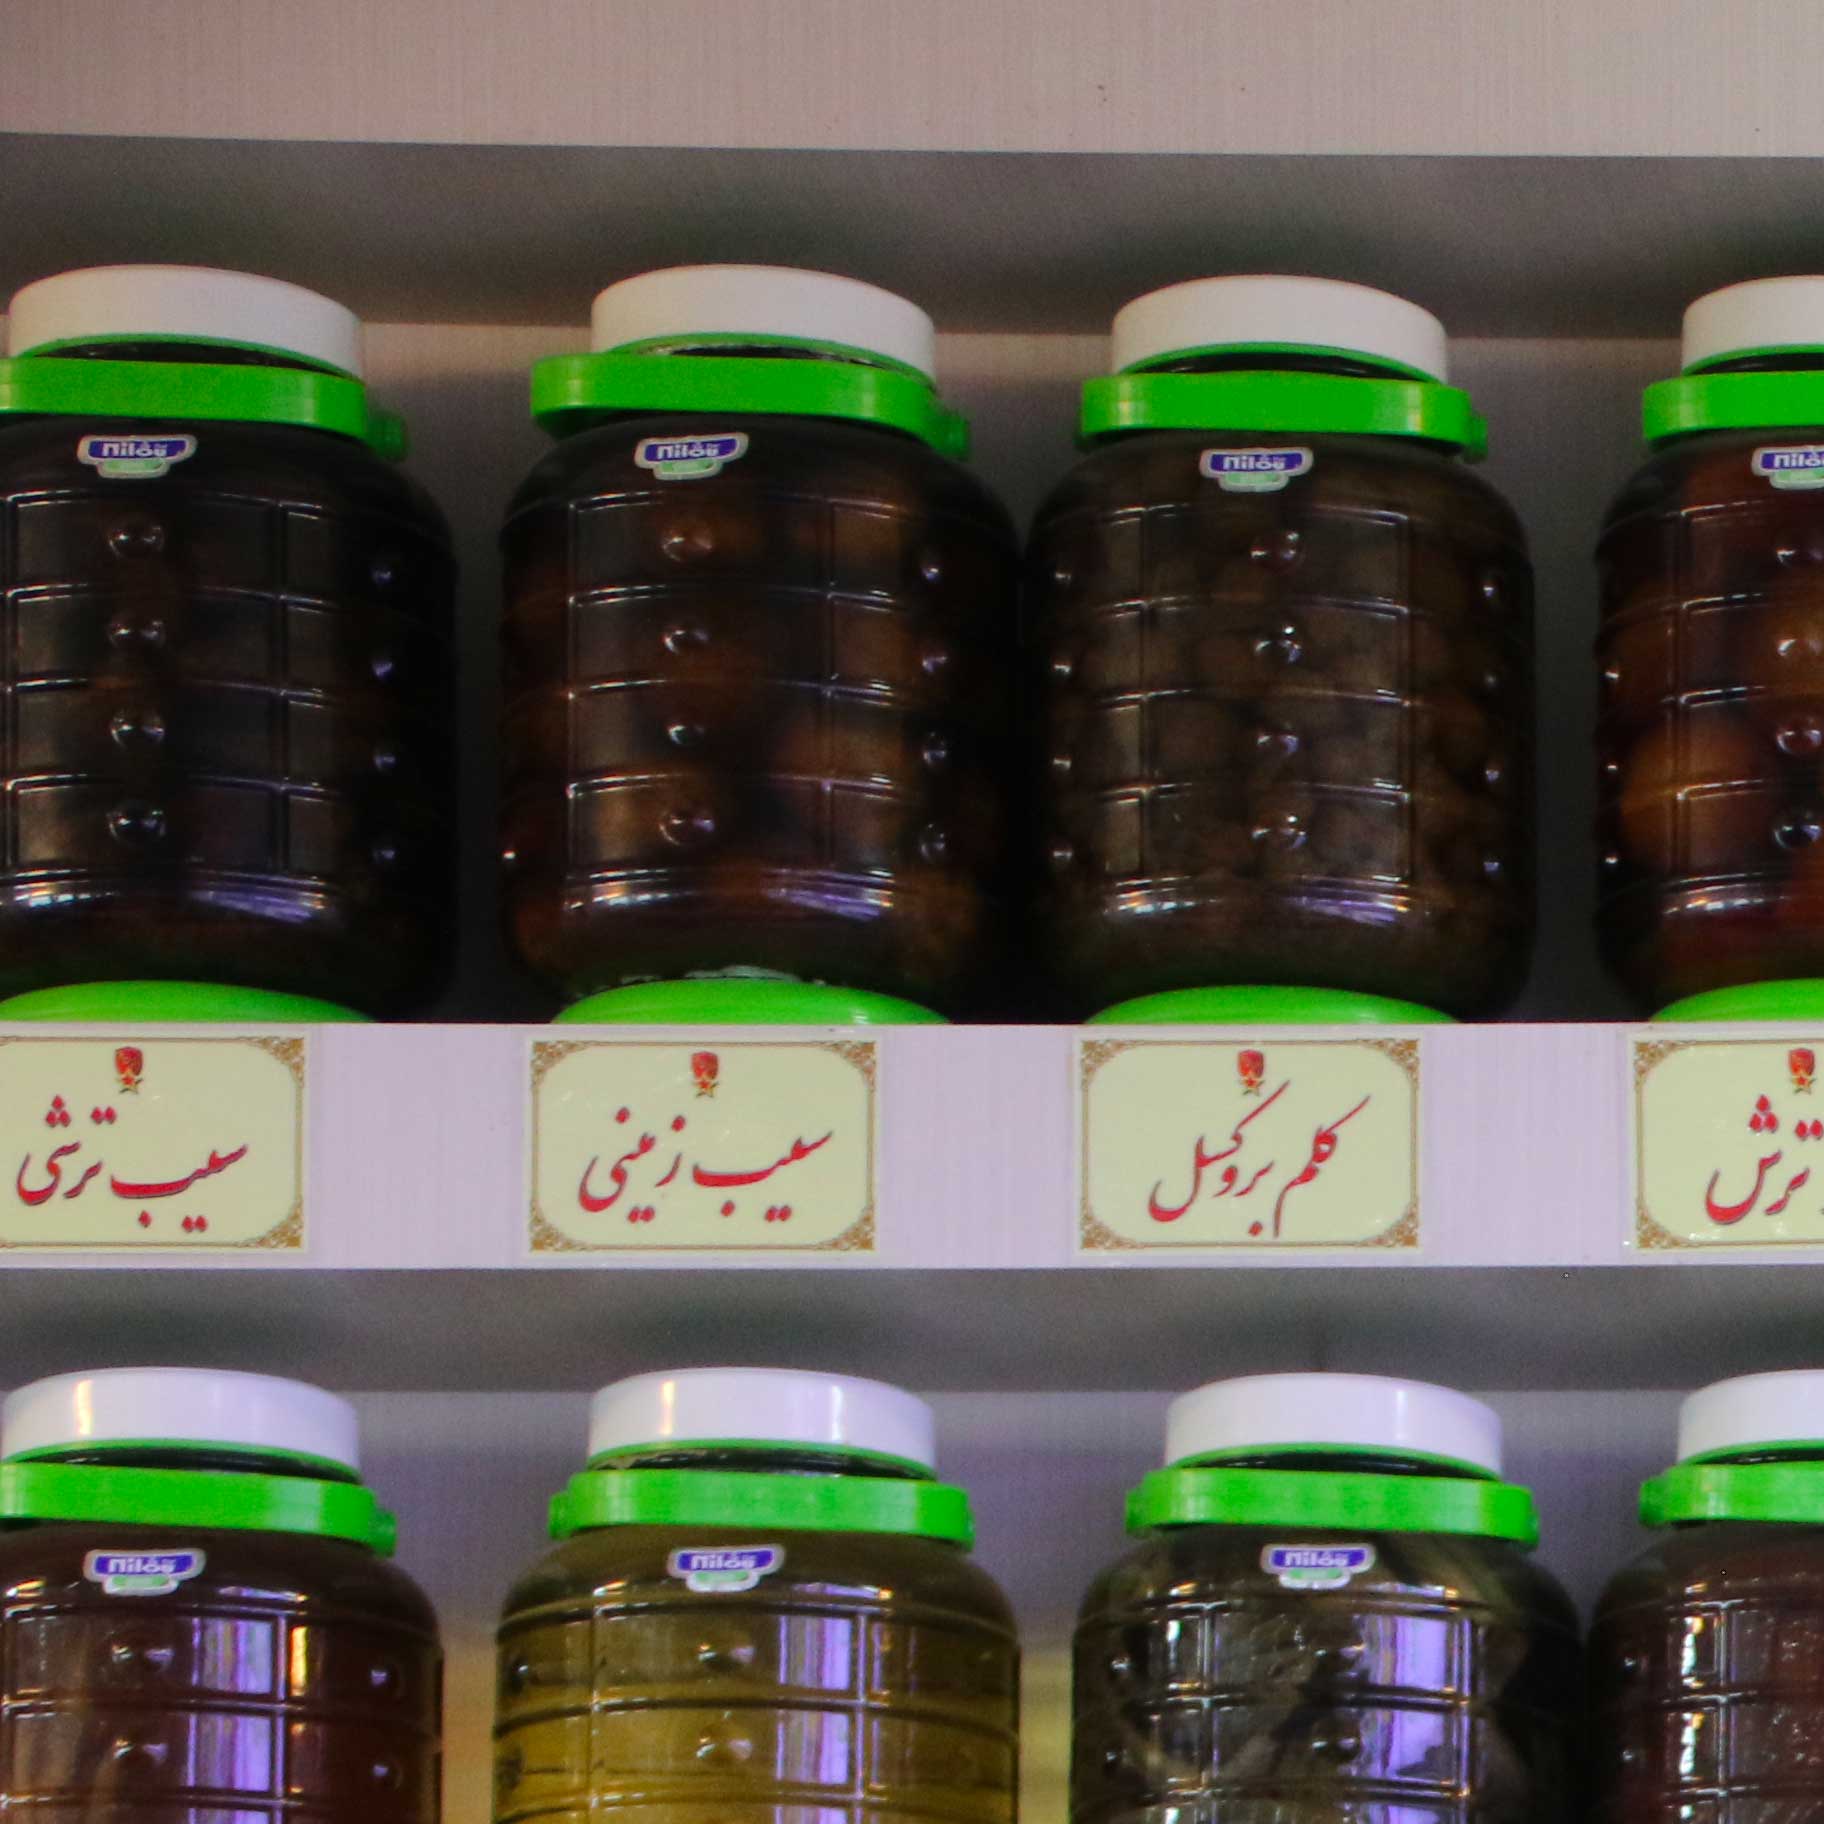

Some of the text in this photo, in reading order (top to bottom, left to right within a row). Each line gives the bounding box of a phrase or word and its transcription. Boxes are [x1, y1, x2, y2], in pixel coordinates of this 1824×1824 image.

[16, 1094, 250, 1236] سیب ترشی
[578, 1108, 834, 1227] سیب زمینی
[1147, 1080, 1371, 1239] کلم بروکسل
